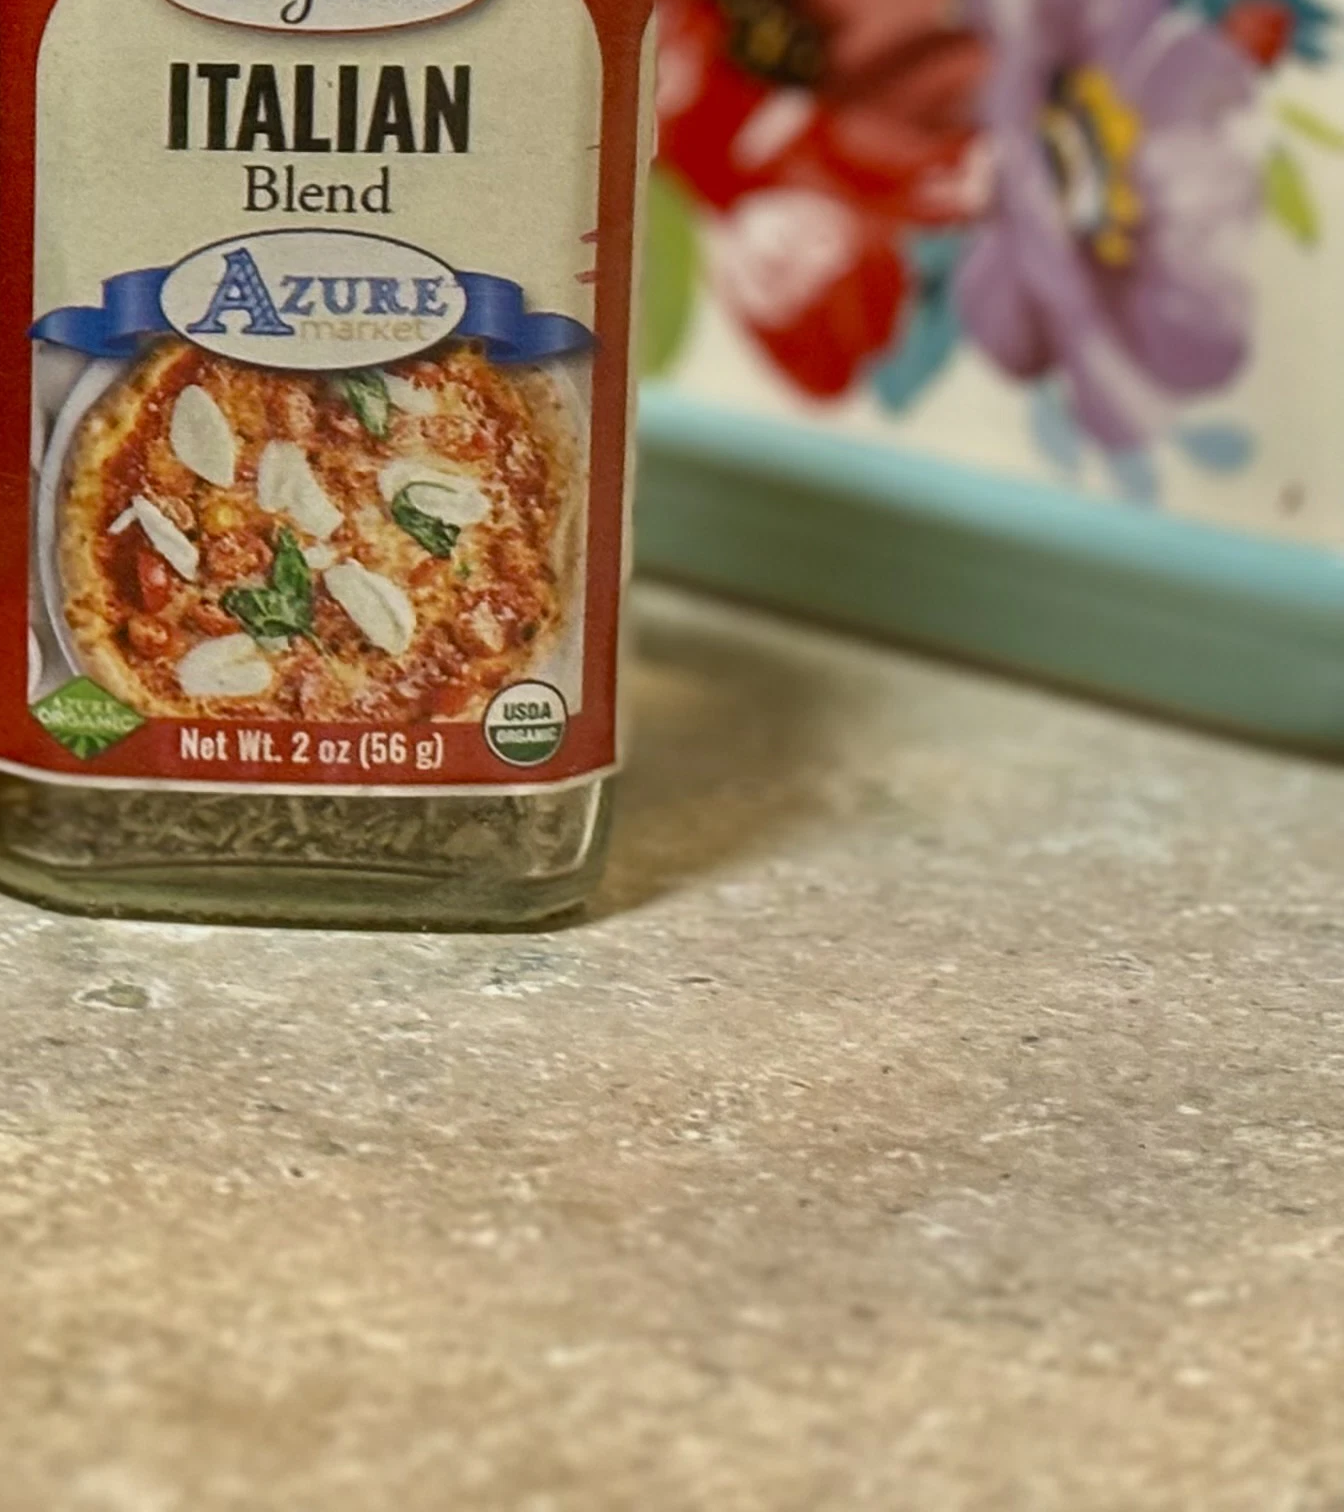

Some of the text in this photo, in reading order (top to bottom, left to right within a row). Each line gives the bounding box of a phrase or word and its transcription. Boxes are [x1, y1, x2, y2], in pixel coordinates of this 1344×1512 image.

[166, 62, 471, 154] ITALIAN
[242, 165, 393, 214] Blend
[185, 247, 449, 336] AZURE
[300, 318, 431, 342] market
[502, 702, 553, 721] USDA
[179, 728, 444, 771] Net Wt. 2 oz (56 g)
[495, 726, 559, 745] ORGANIC
